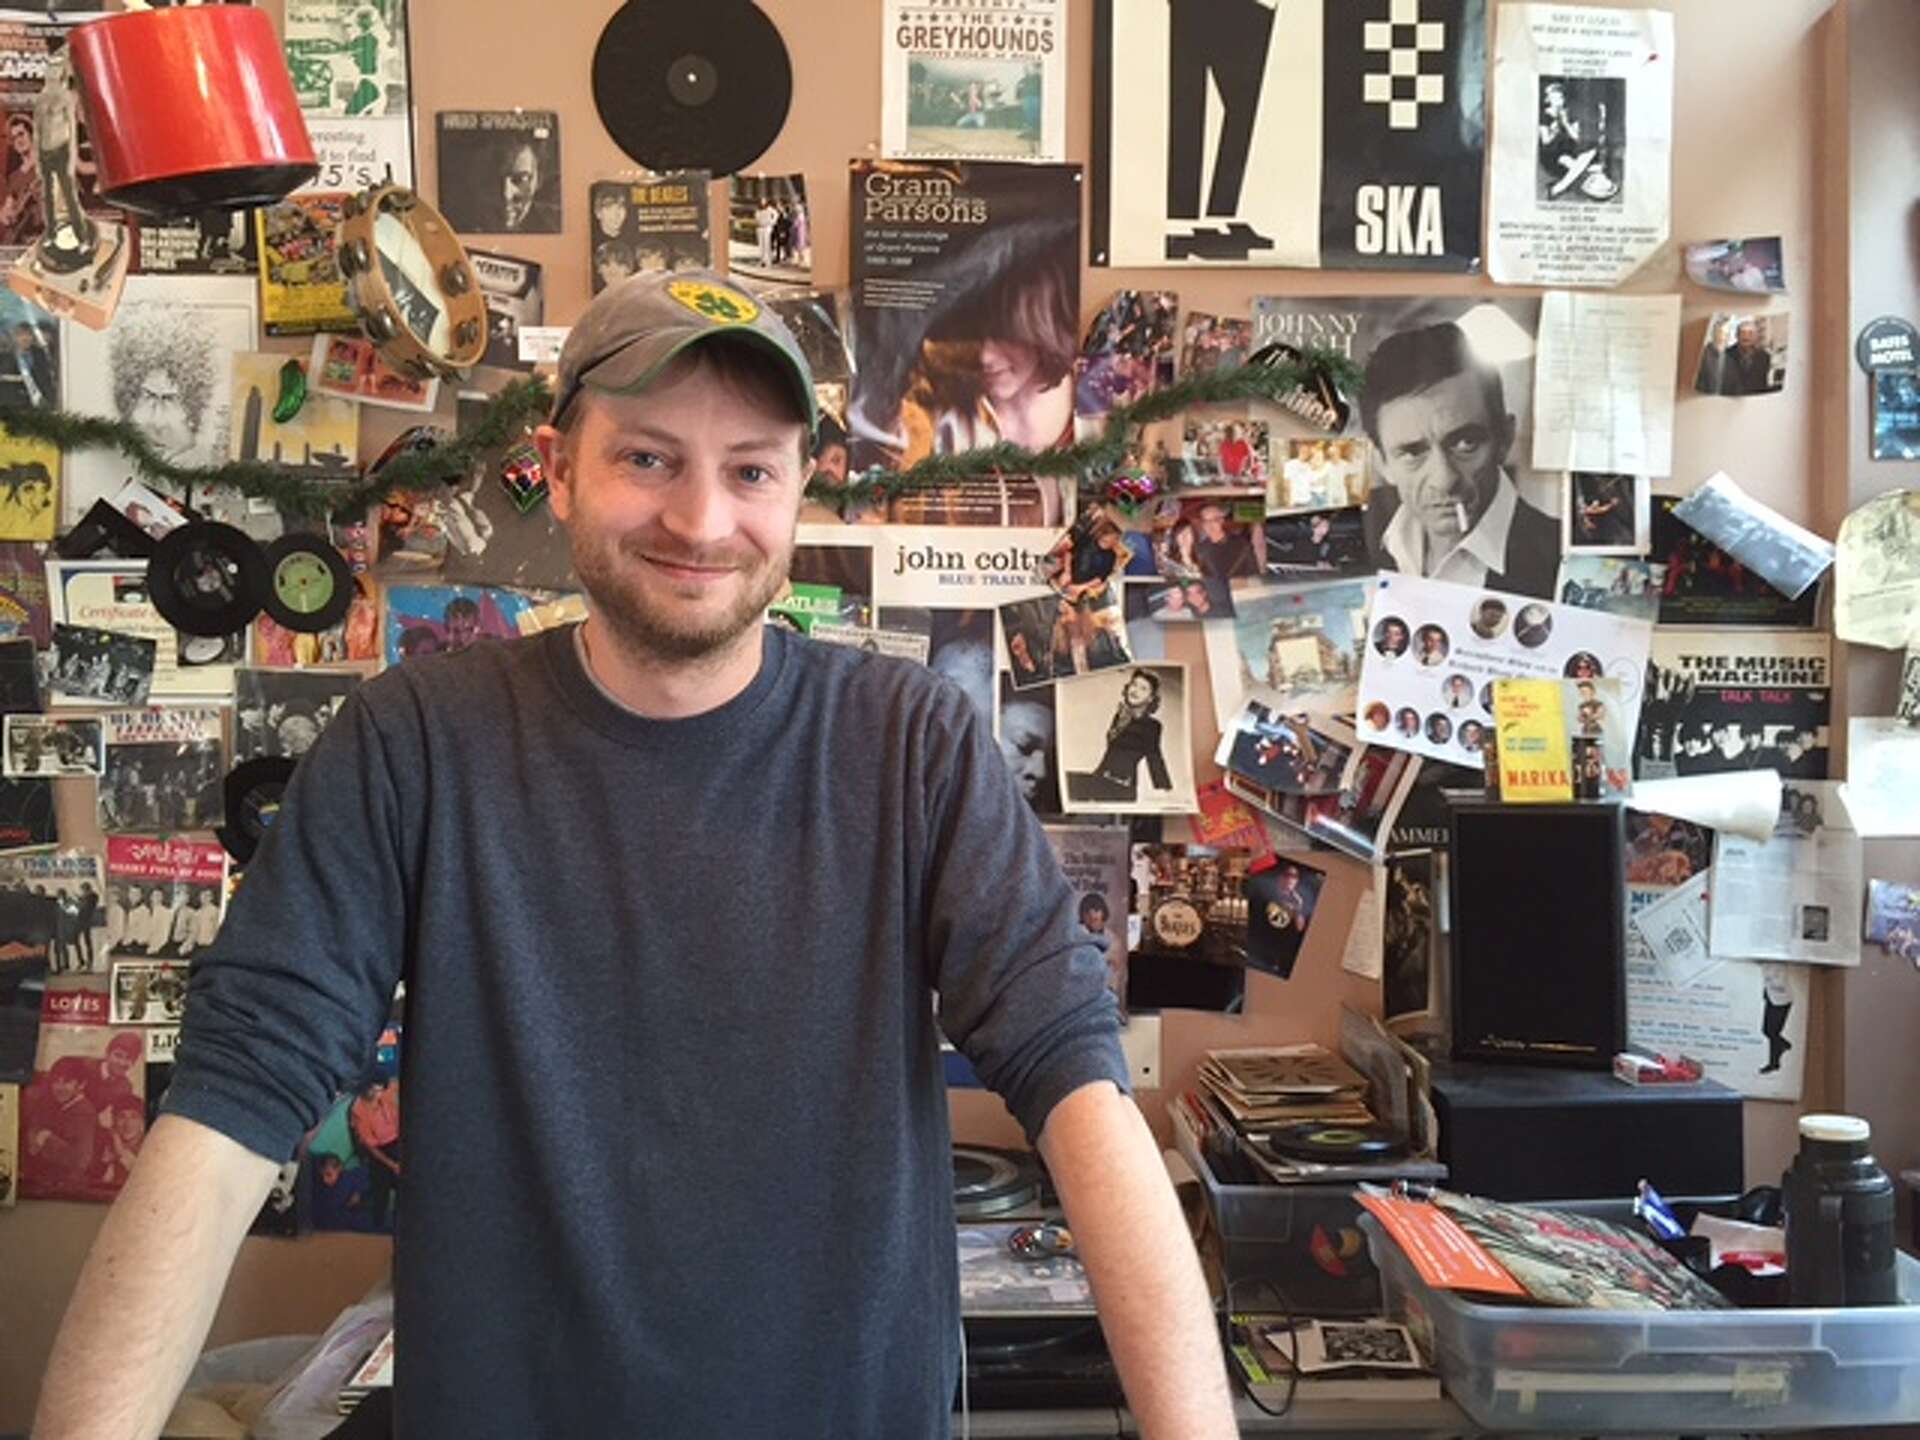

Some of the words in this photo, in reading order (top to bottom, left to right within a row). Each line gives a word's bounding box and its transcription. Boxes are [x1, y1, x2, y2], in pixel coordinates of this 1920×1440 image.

[961, 14, 992, 24] THE
[896, 26, 1054, 53] GREYHOUNDS
[865, 173, 952, 198] Gram
[864, 197, 987, 223] Parsons
[1355, 185, 1444, 255] SKA
[1256, 314, 1362, 334] JOHNNY
[894, 545, 966, 575] john
[938, 574, 974, 585] BLUE
[982, 575, 1025, 585] TRAIN
[1679, 656, 1730, 669] THE
[1735, 656, 1826, 670] MUSIC
[1699, 671, 1825, 684] MACHINE
